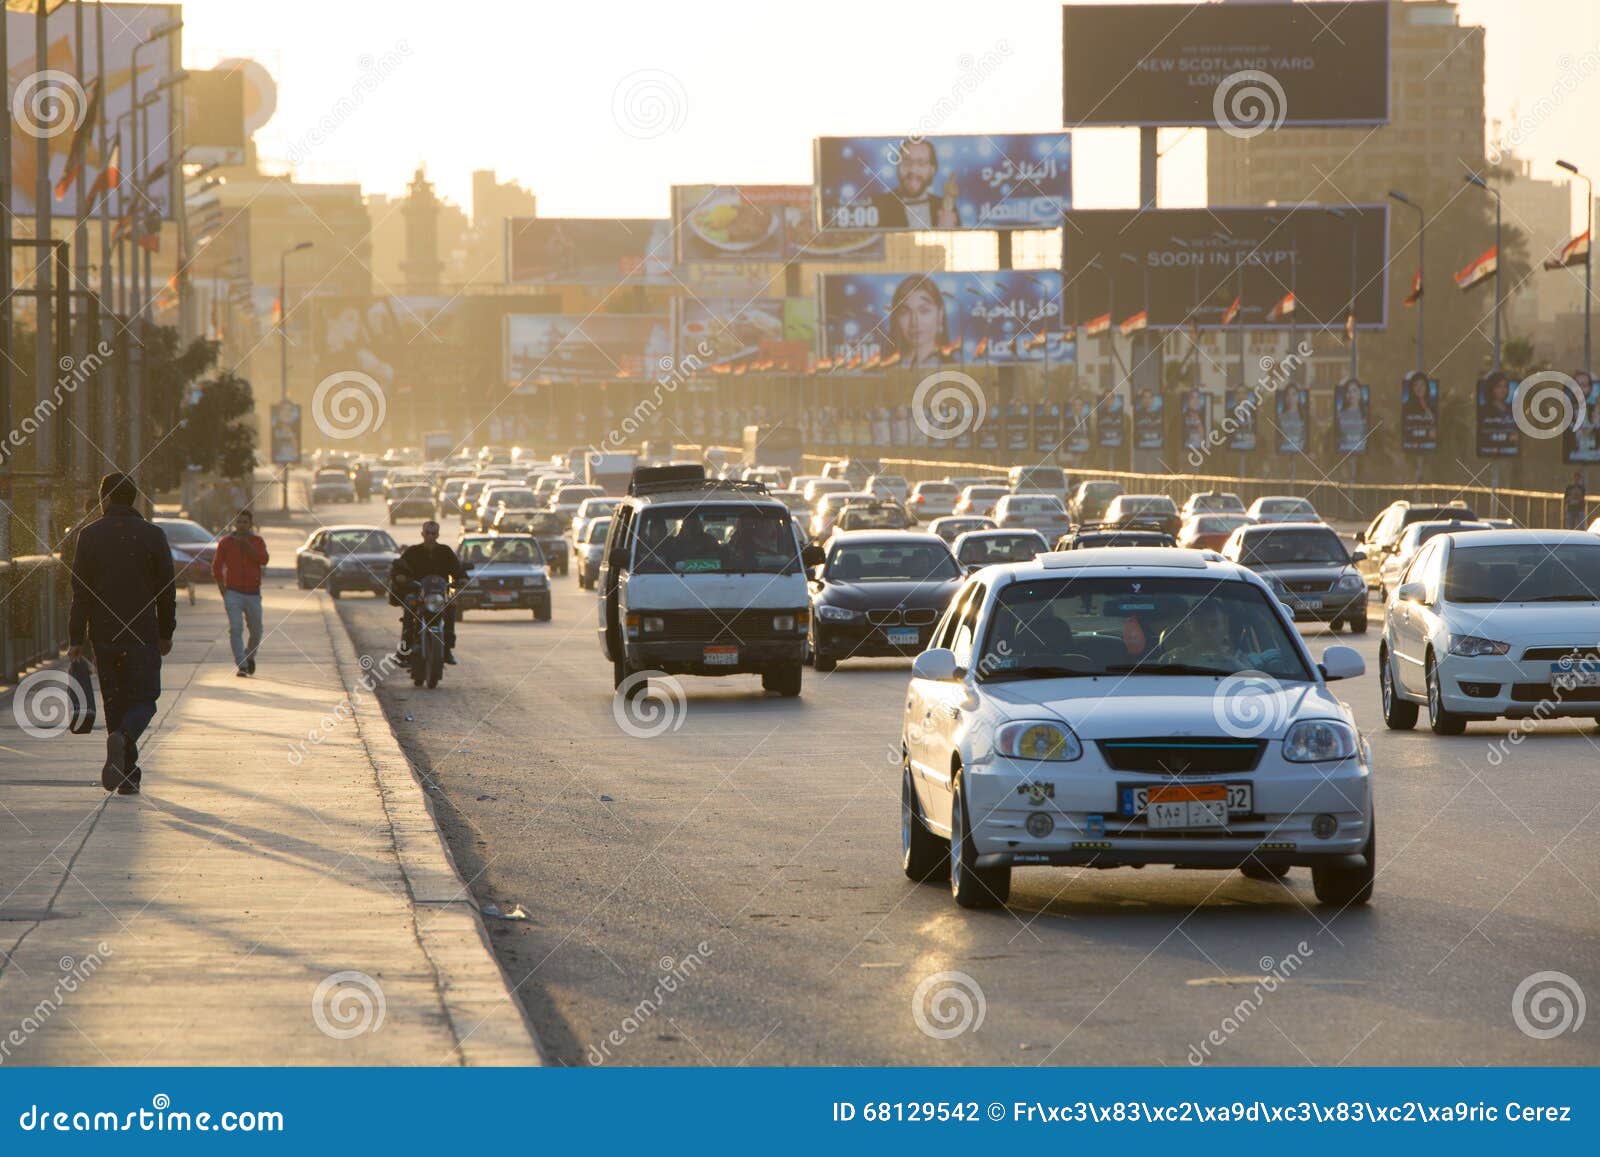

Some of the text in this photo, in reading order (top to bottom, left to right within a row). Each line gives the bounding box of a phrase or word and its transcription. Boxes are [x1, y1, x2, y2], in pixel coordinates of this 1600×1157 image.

[1136, 57, 1314, 72] NEW SCOTLAND YARD
[1188, 74, 1258, 86] LONN
[1147, 251, 1204, 267] SOON
[1210, 252, 1229, 265] IN
